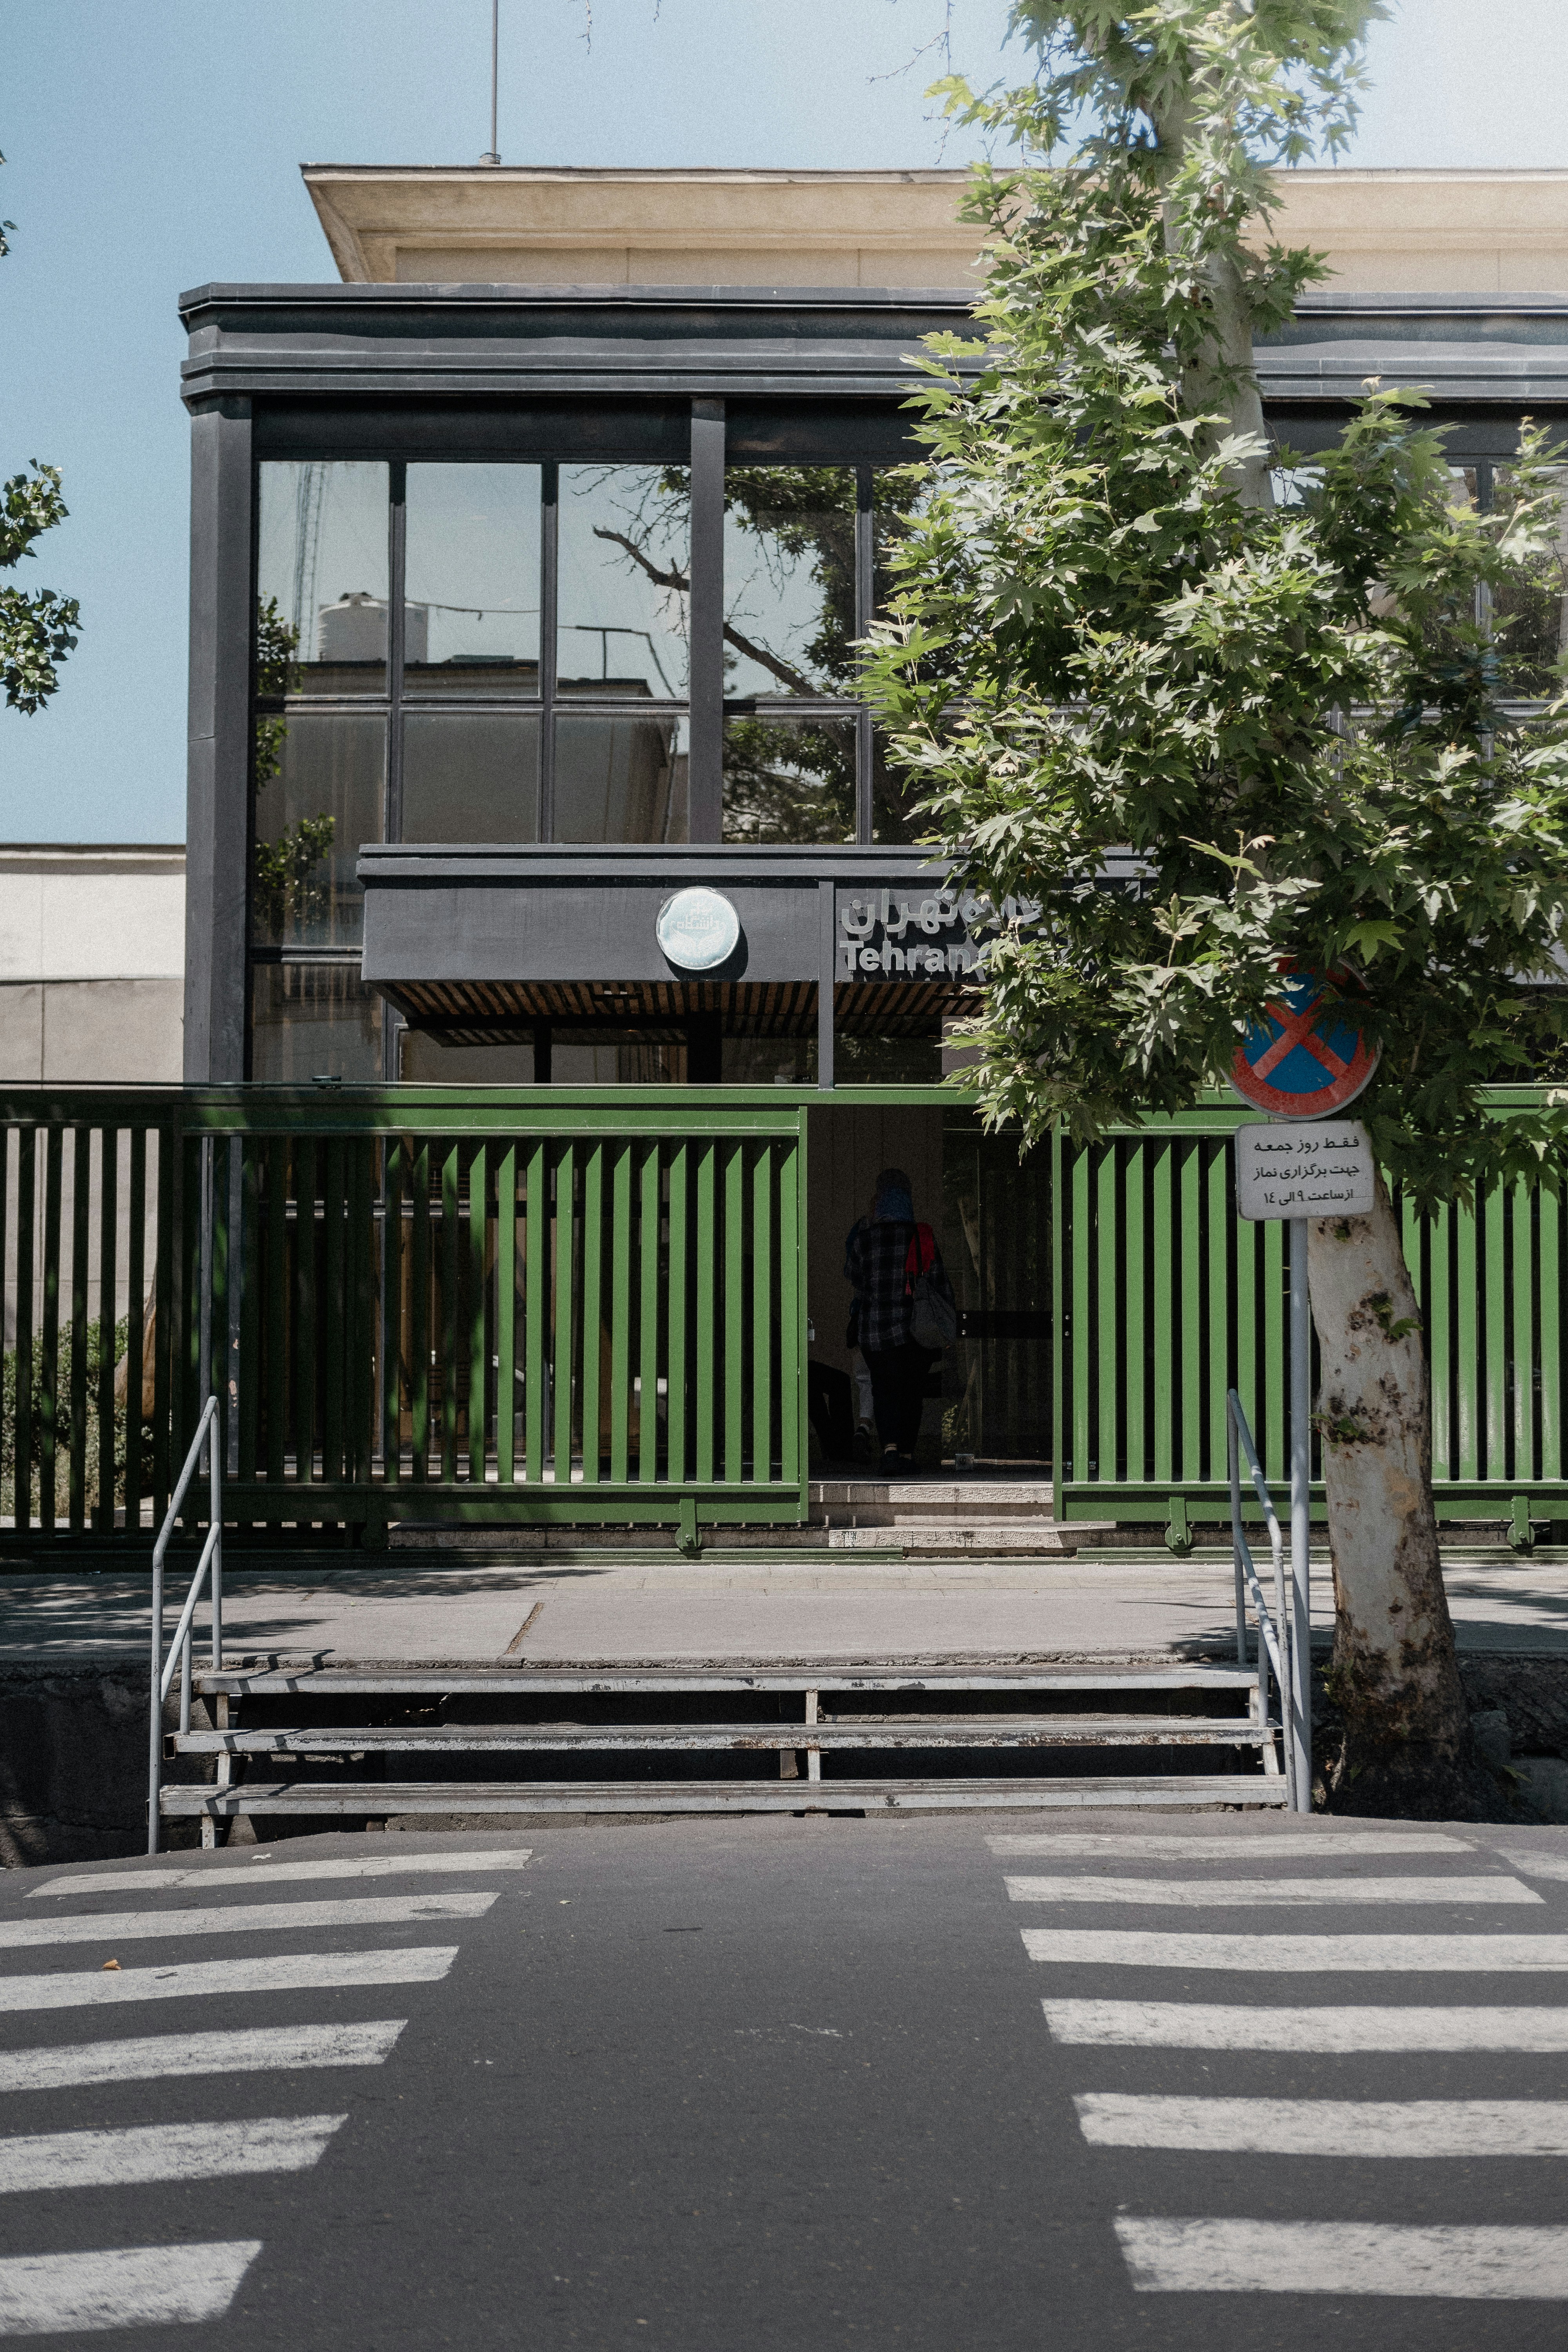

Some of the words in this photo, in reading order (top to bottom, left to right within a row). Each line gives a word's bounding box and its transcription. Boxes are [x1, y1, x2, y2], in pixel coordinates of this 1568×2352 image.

[841, 889, 958, 934] تهران
[839, 941, 971, 972] Tehran
[1254, 1142, 1293, 1154] جمعه
[1297, 1140, 1318, 1154] روز
[1323, 1136, 1359, 1149] فقط
[1253, 1167, 1277, 1181] نماز
[1279, 1163, 1327, 1180] برگزاری
[1329, 1166, 1360, 1177] جهت
